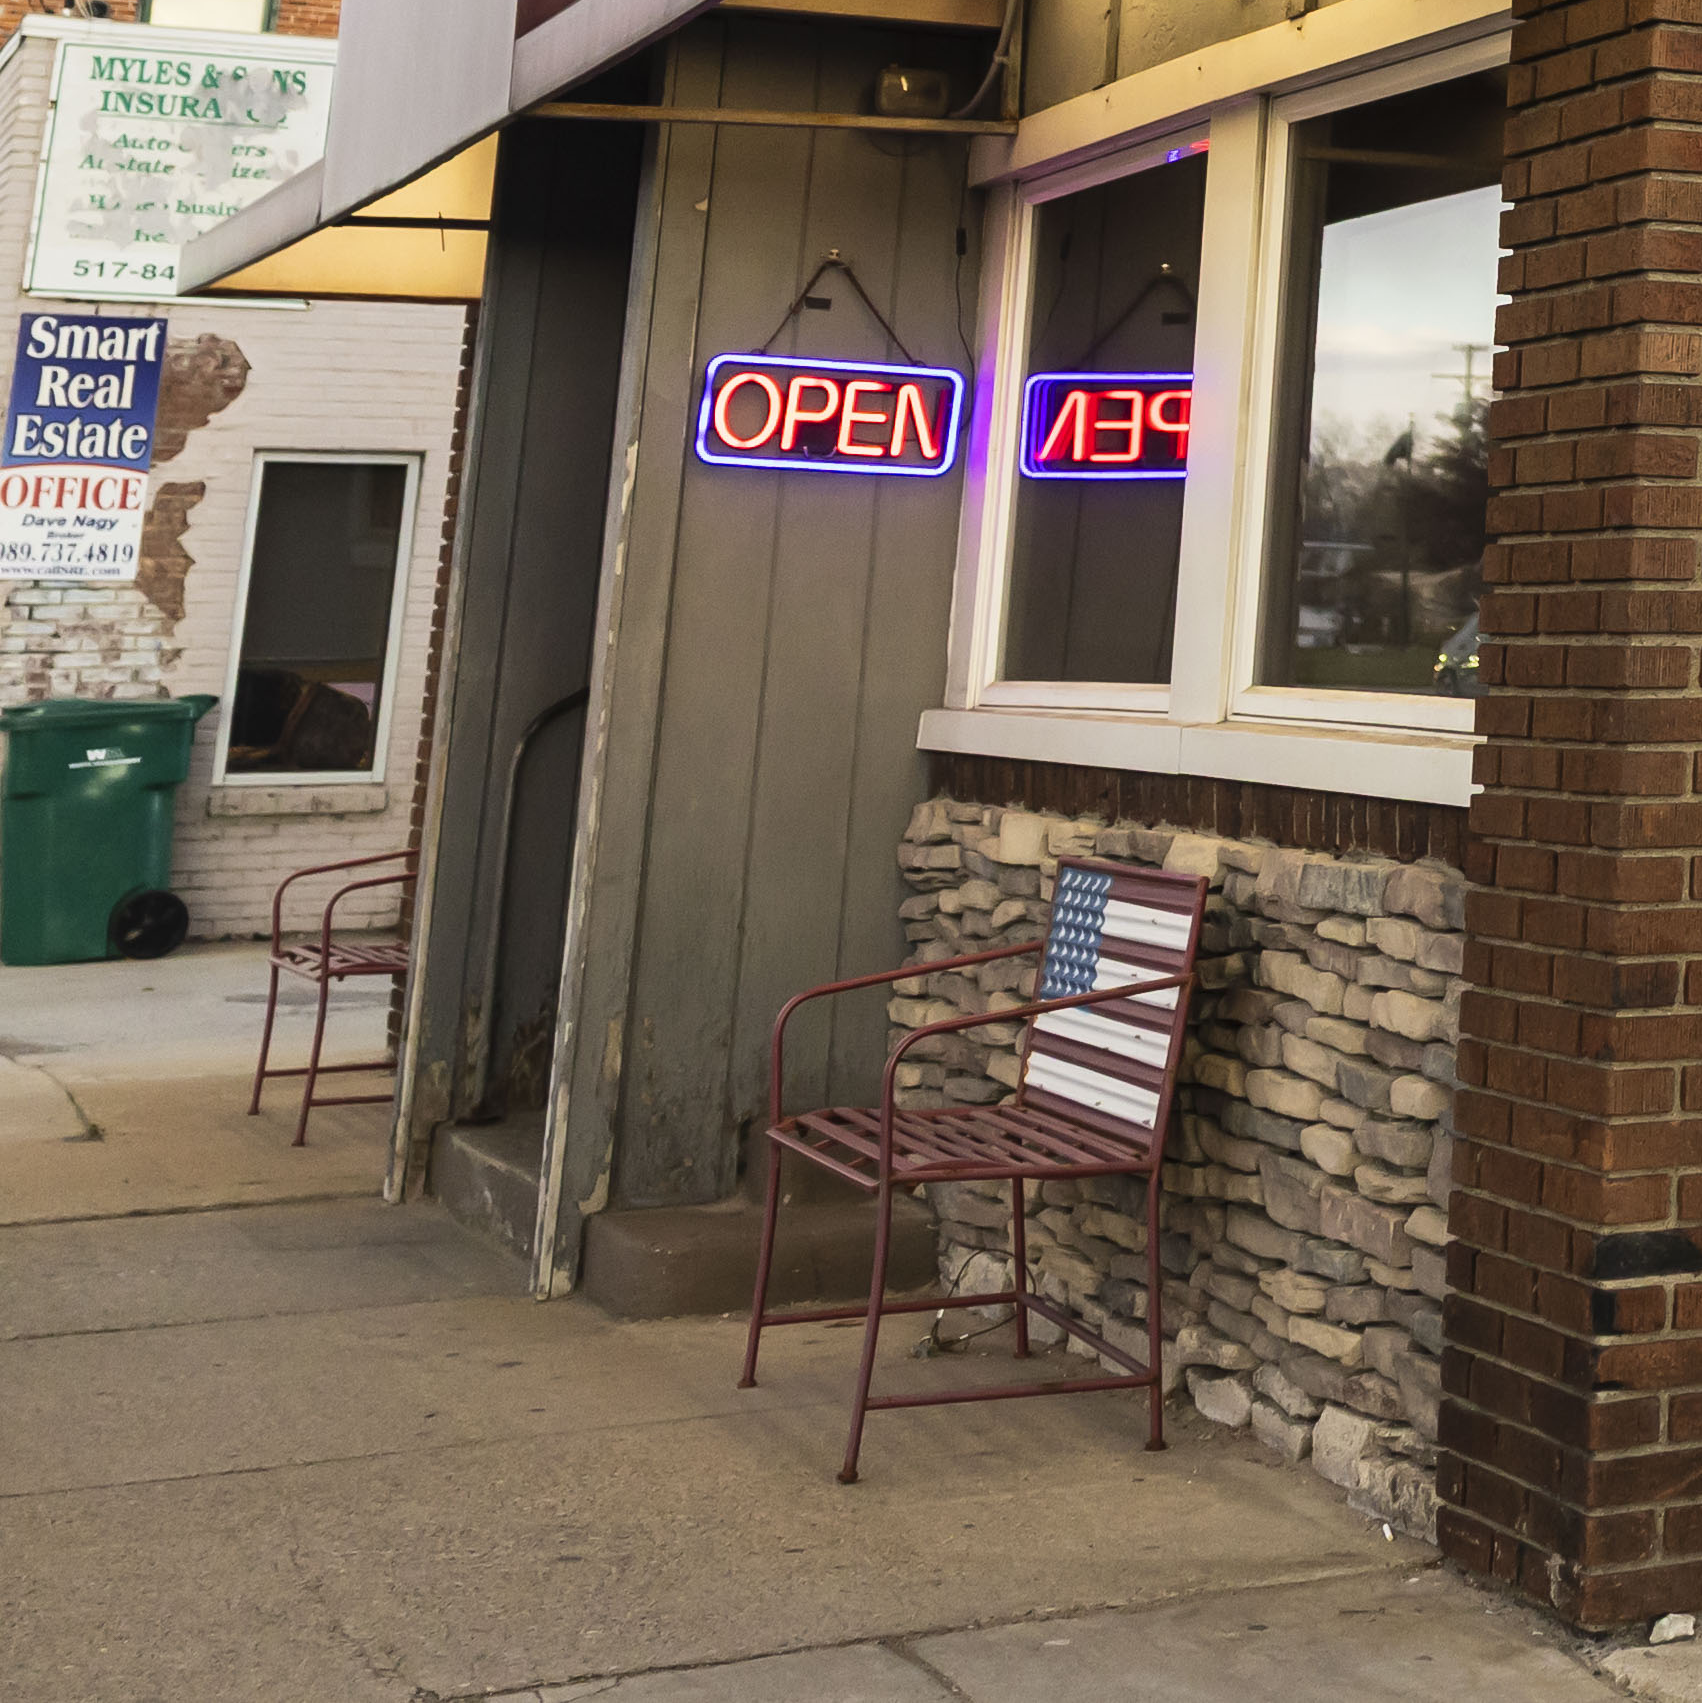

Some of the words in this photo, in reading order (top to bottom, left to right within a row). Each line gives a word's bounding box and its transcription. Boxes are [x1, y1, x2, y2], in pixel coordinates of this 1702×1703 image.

[89, 55, 192, 88] MYLES
[200, 63, 223, 90] &
[232, 66, 307, 96] SNS
[27, 315, 161, 362] Smart
[36, 364, 136, 410] Real
[11, 414, 149, 460] Estate
[713, 372, 947, 460] OPEN
[0, 474, 143, 511] OFFICE
[22, 514, 67, 527] Dave
[72, 515, 119, 531] Nagy
